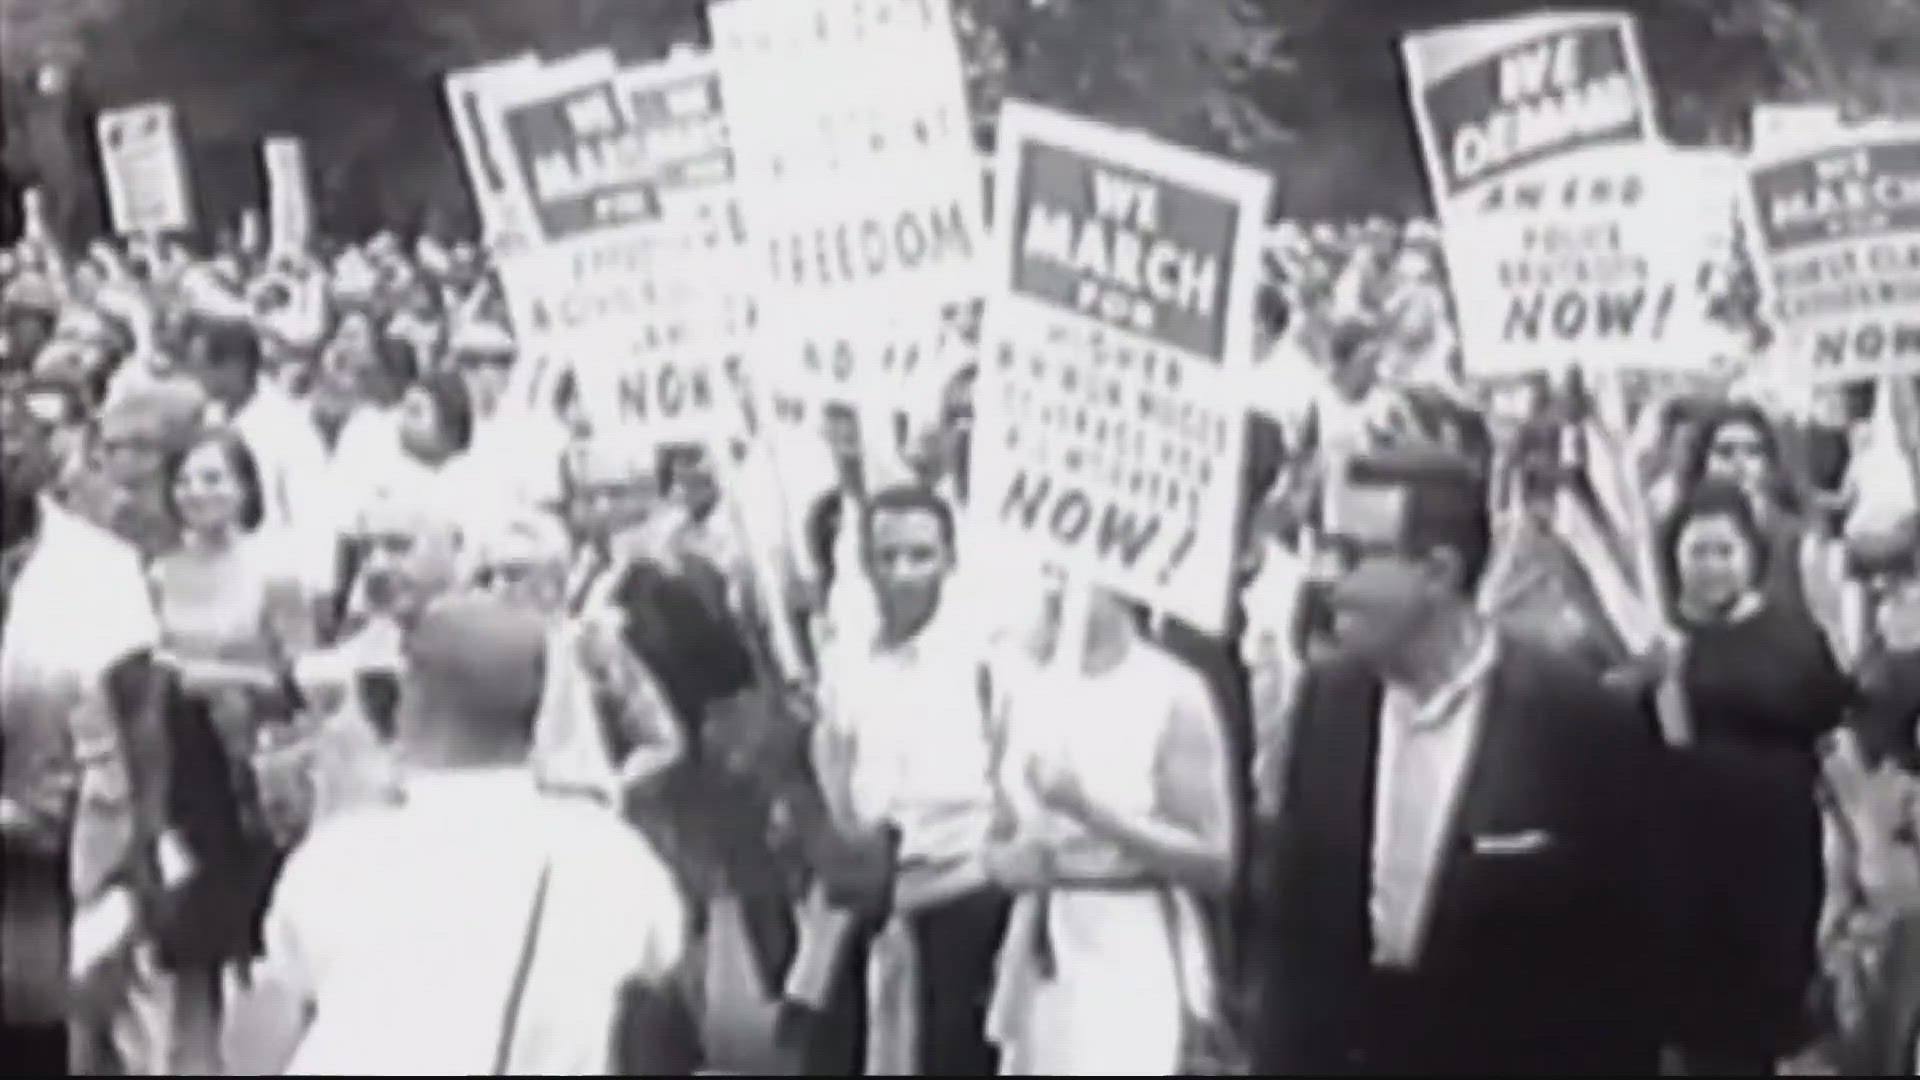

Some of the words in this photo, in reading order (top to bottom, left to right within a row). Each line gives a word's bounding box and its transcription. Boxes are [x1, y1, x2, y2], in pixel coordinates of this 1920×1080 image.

[1500, 36, 1580, 101] WE
[1095, 168, 1158, 230] WE
[1023, 203, 1217, 314] MARCH
[1076, 280, 1154, 331] FOR
[1502, 283, 1677, 342] NOW!
[999, 467, 1198, 588] NOW!
